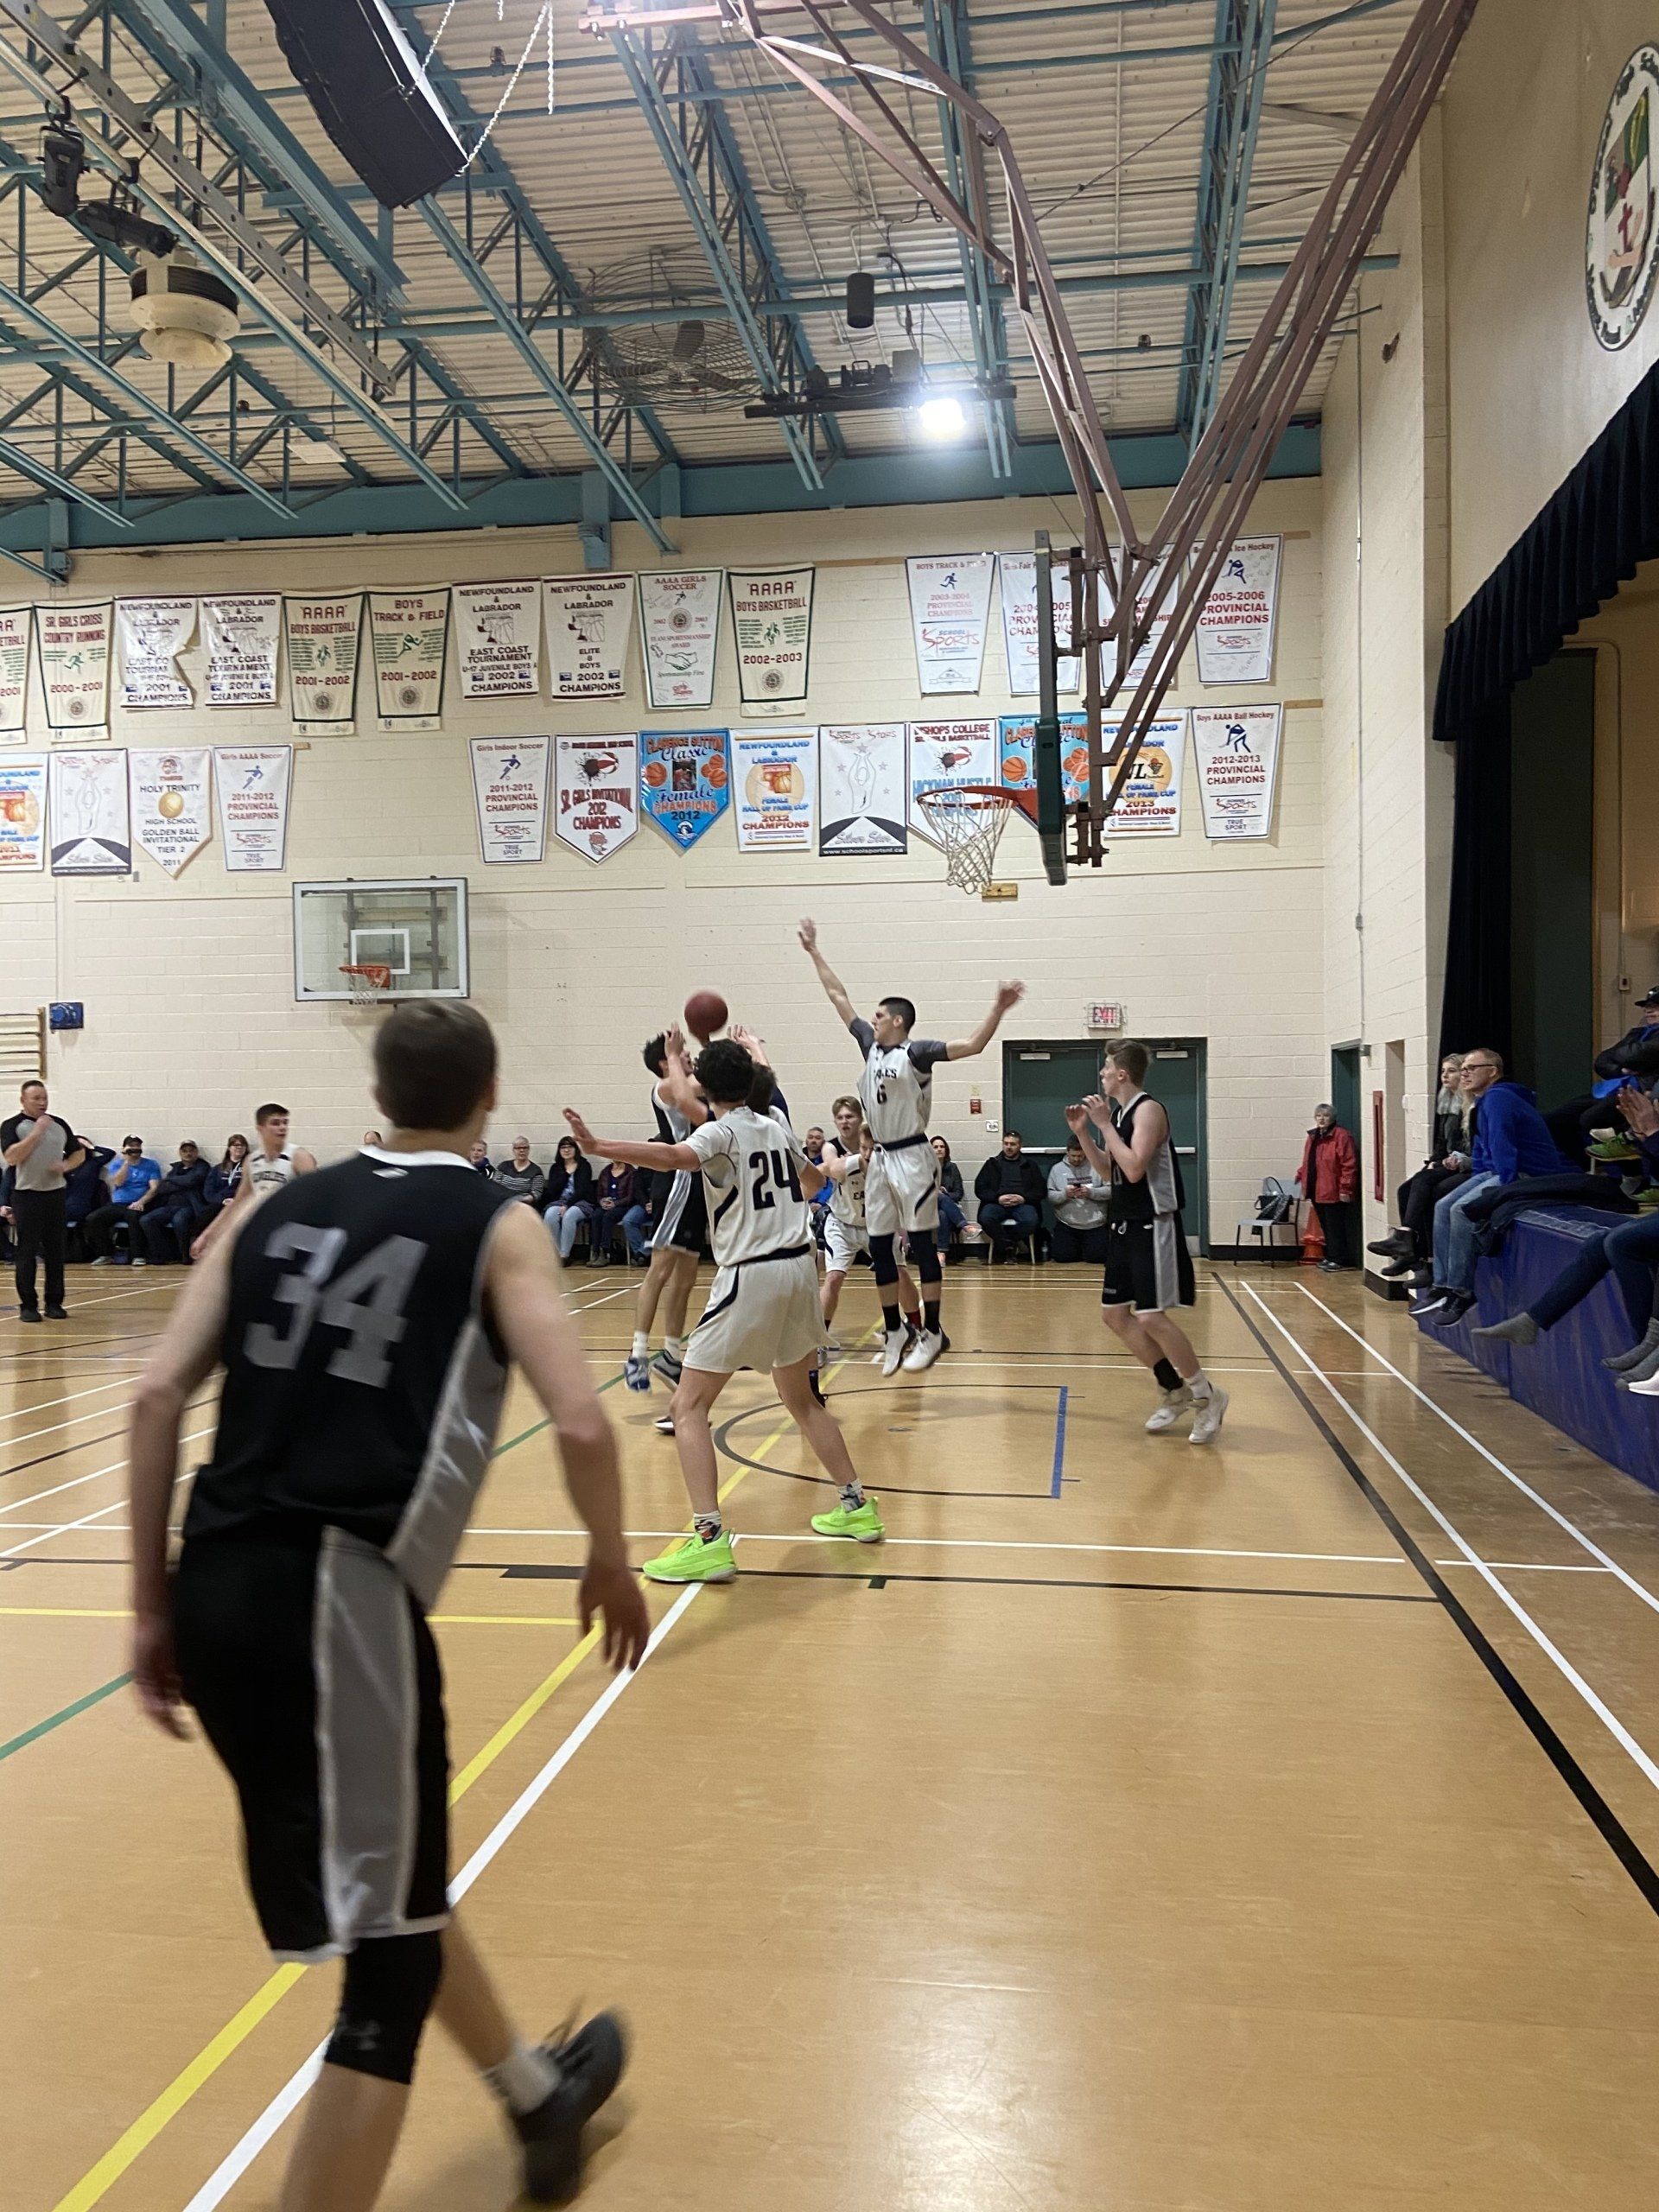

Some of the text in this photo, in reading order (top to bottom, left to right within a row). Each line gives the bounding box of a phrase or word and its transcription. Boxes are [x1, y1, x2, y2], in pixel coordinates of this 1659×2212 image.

[460, 586, 534, 596] NEWFOUNDLAND
[550, 582, 626, 594] NEWFOUNDLAND
[203, 599, 276, 607] NEWFOUNDLAND
[395, 599, 423, 608] BOYS
[564, 600, 613, 609] LABRADOR
[736, 597, 807, 612] BOYS BASKETBALL
[473, 604, 521, 613] LABRADOR
[373, 612, 404, 622] TRACK
[419, 609, 445, 620] FIELD
[1200, 614, 1269, 625] CHAMPIONS
[498, 645, 529, 654] COAST
[467, 653, 532, 664] TOURNAMENT
[577, 672, 605, 681] 2002
[472, 681, 532, 692] CHAMPIONS
[560, 682, 621, 692] CHAMPIONS
[212, 692, 271, 701] CHAMPIONS
[953, 724, 990, 734] COLLEGE
[740, 741, 810, 750] NEWFOUNDLAND
[1212, 755, 1261, 764] 2012-2013
[1207, 776, 1265, 785] CHAMPIONS
[588, 802, 607, 815] 2012
[652, 800, 718, 814] CHAMPIONS
[671, 811, 700, 820] 2012
[573, 816, 621, 830] CHAMPIONS
[1092, 1007, 1116, 1023] EXIT
[876, 1084, 887, 1105] 6
[749, 1148, 804, 1211] 24
[242, 1221, 429, 1389] 34
